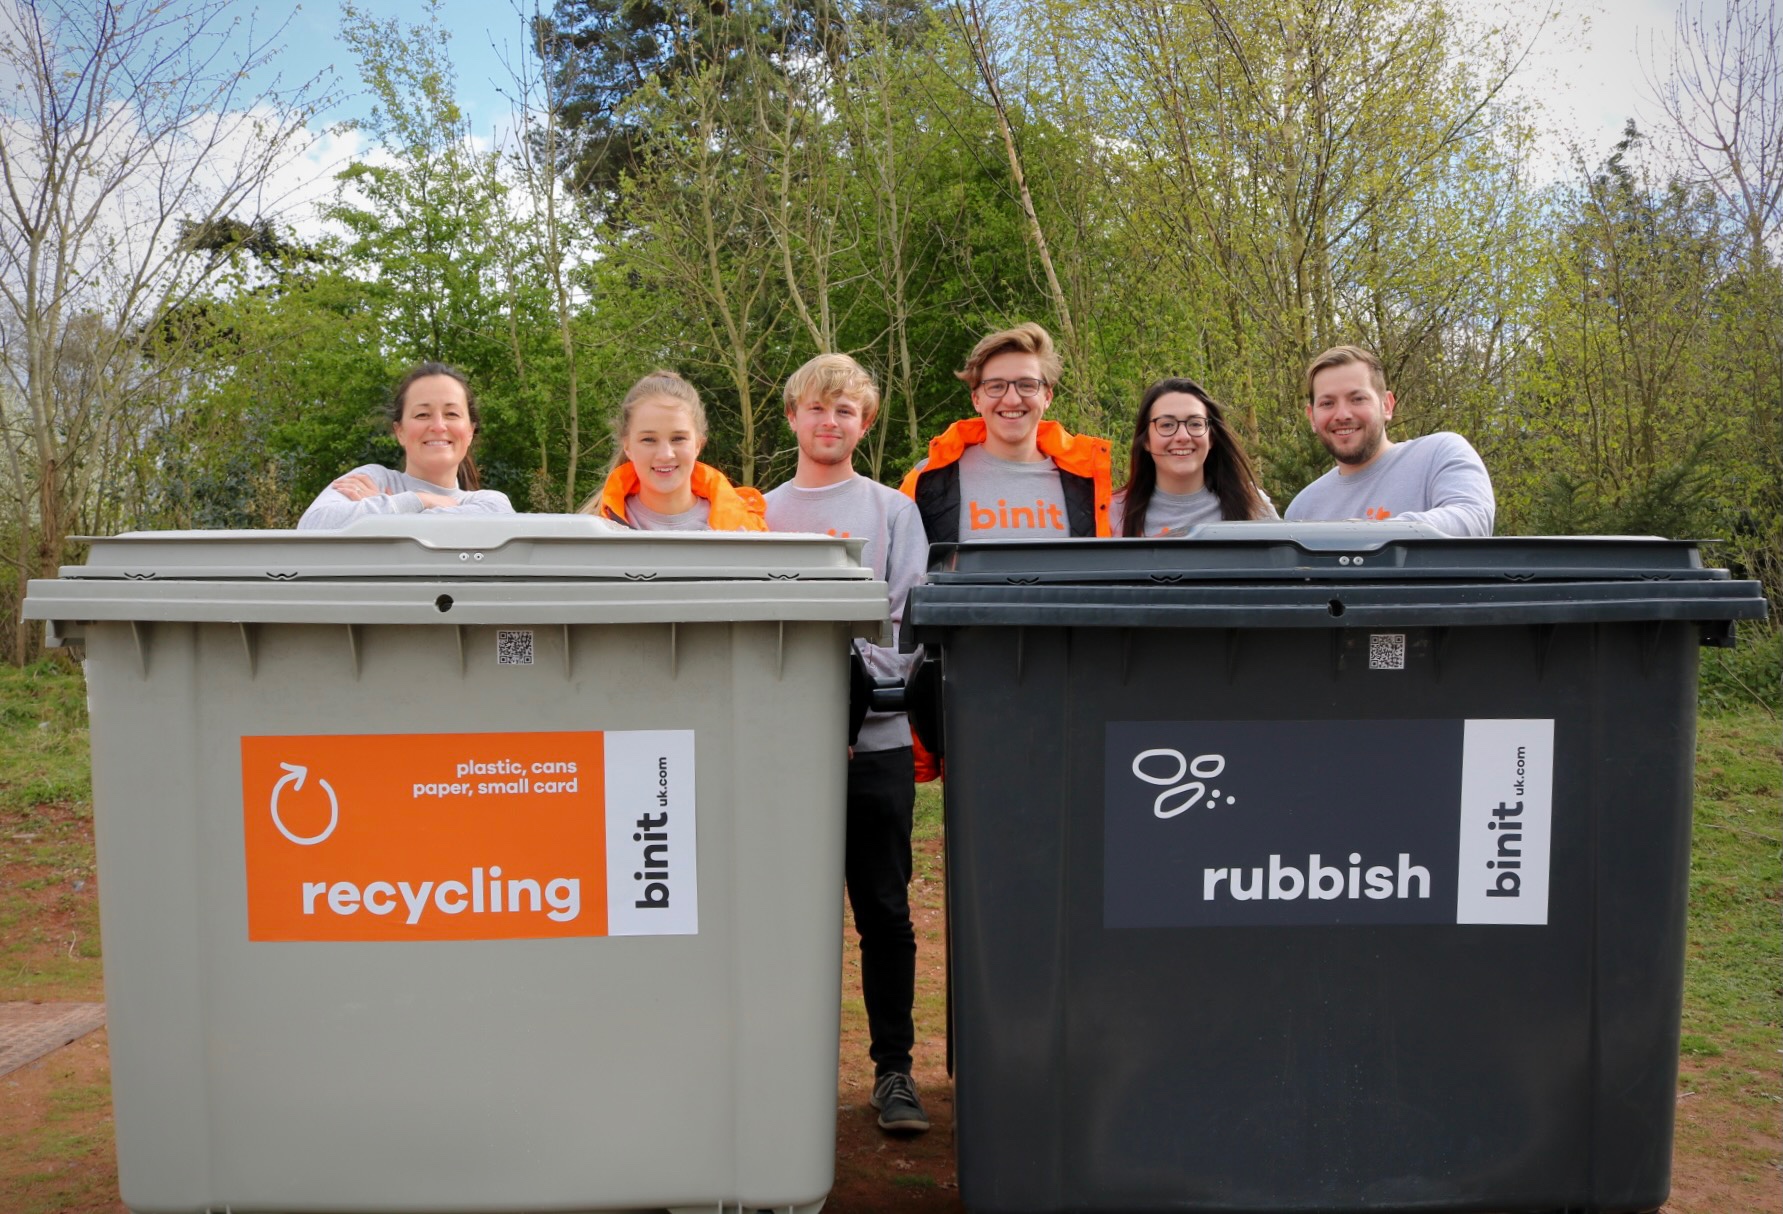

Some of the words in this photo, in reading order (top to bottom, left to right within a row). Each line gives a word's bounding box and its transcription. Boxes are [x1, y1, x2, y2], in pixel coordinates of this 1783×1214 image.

[969, 499, 1065, 530] binit
[412, 780, 474, 799] paper,
[477, 777, 529, 795] small
[533, 777, 578, 794] card
[456, 758, 527, 779] plastic,
[530, 762, 578, 774] cans
[632, 811, 670, 909] binit
[657, 756, 668, 807] uk.com
[1485, 800, 1524, 898] binit
[1515, 746, 1526, 796] uk.com
[302, 865, 581, 925] recycling
[1202, 852, 1431, 901] rubbish
